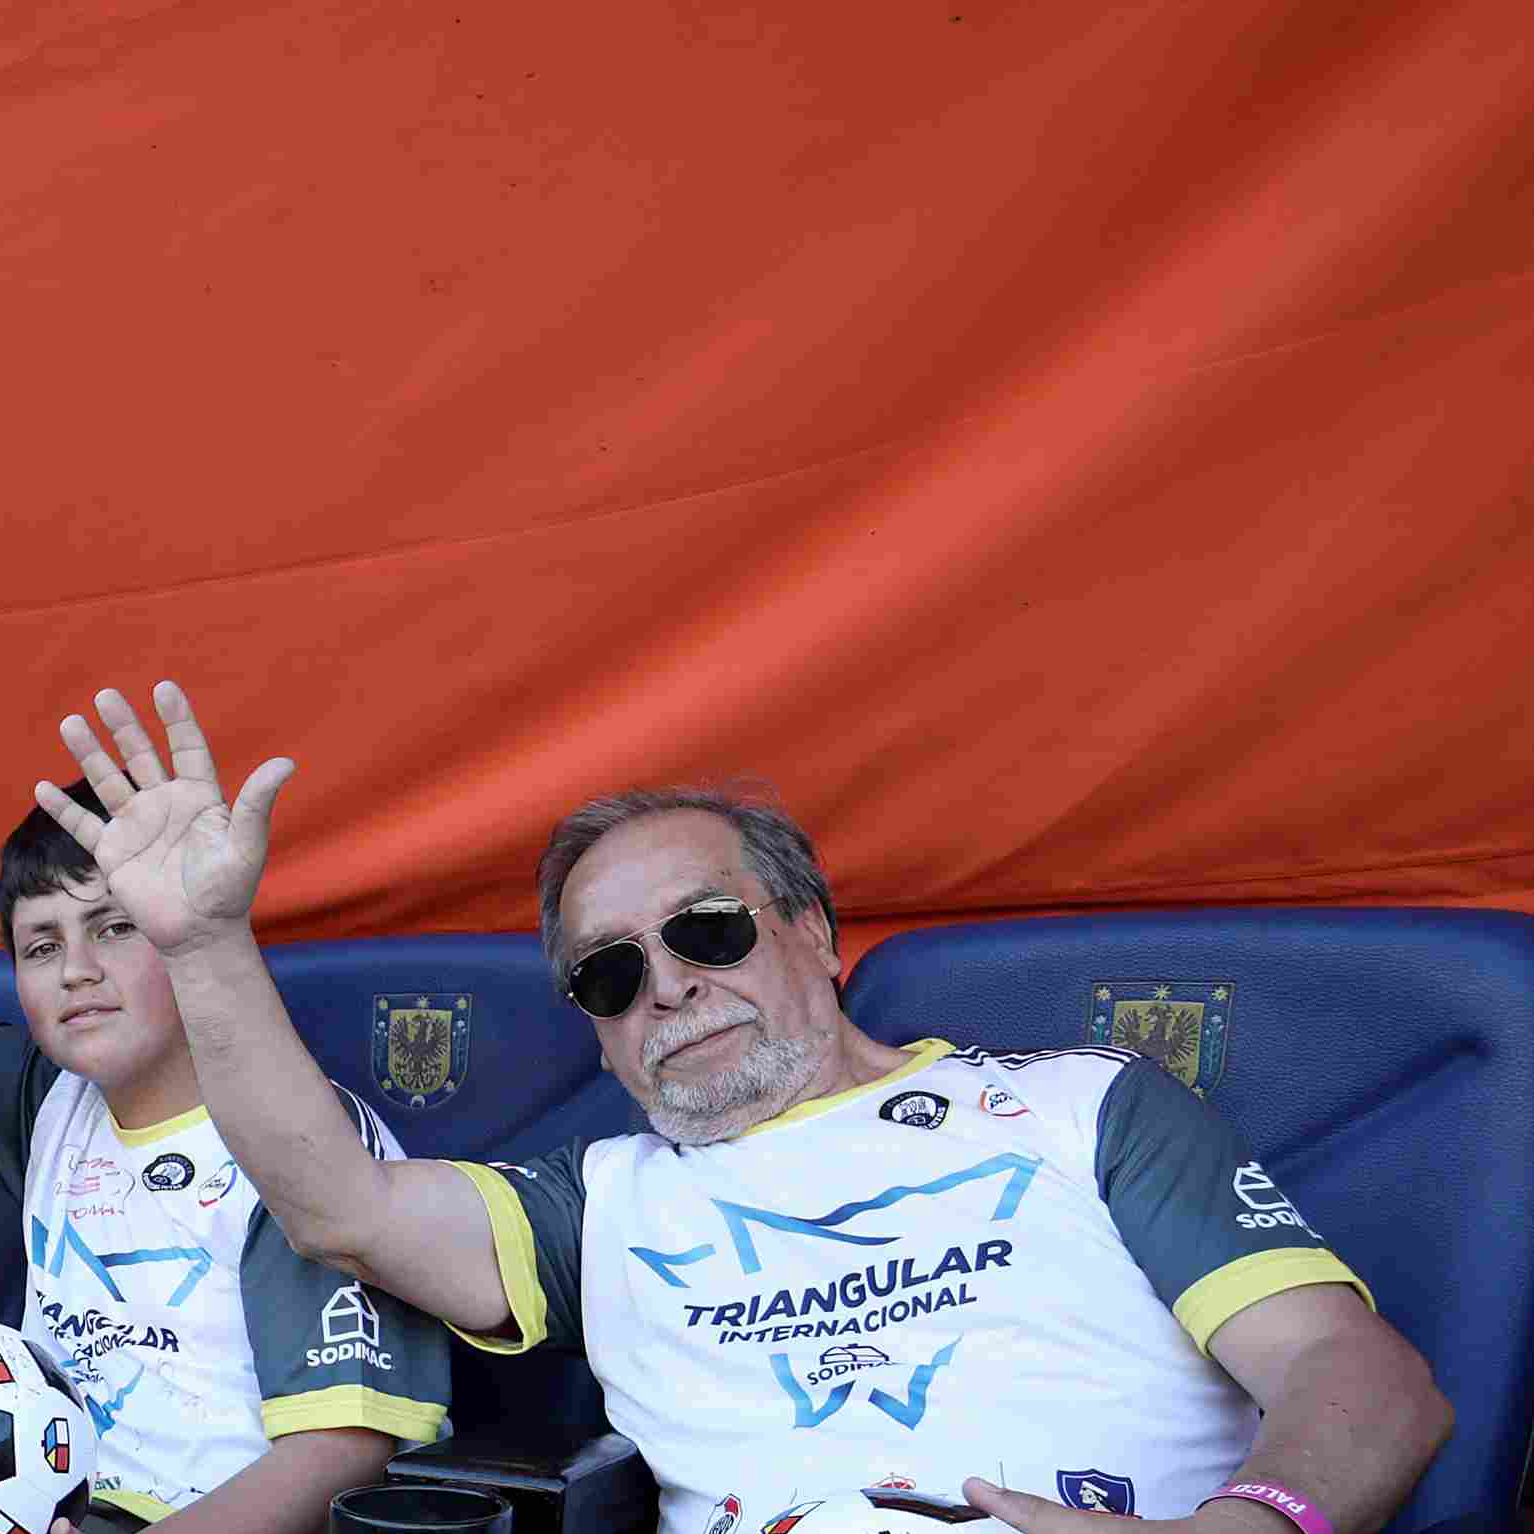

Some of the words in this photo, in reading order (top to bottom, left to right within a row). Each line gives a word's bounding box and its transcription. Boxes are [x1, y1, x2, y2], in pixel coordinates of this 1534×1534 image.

[684, 1239, 1013, 1328] TRIANGULAR
[718, 1283, 978, 1345] INTERNACIONAL
[1230, 1483, 1307, 1514] PALCO
